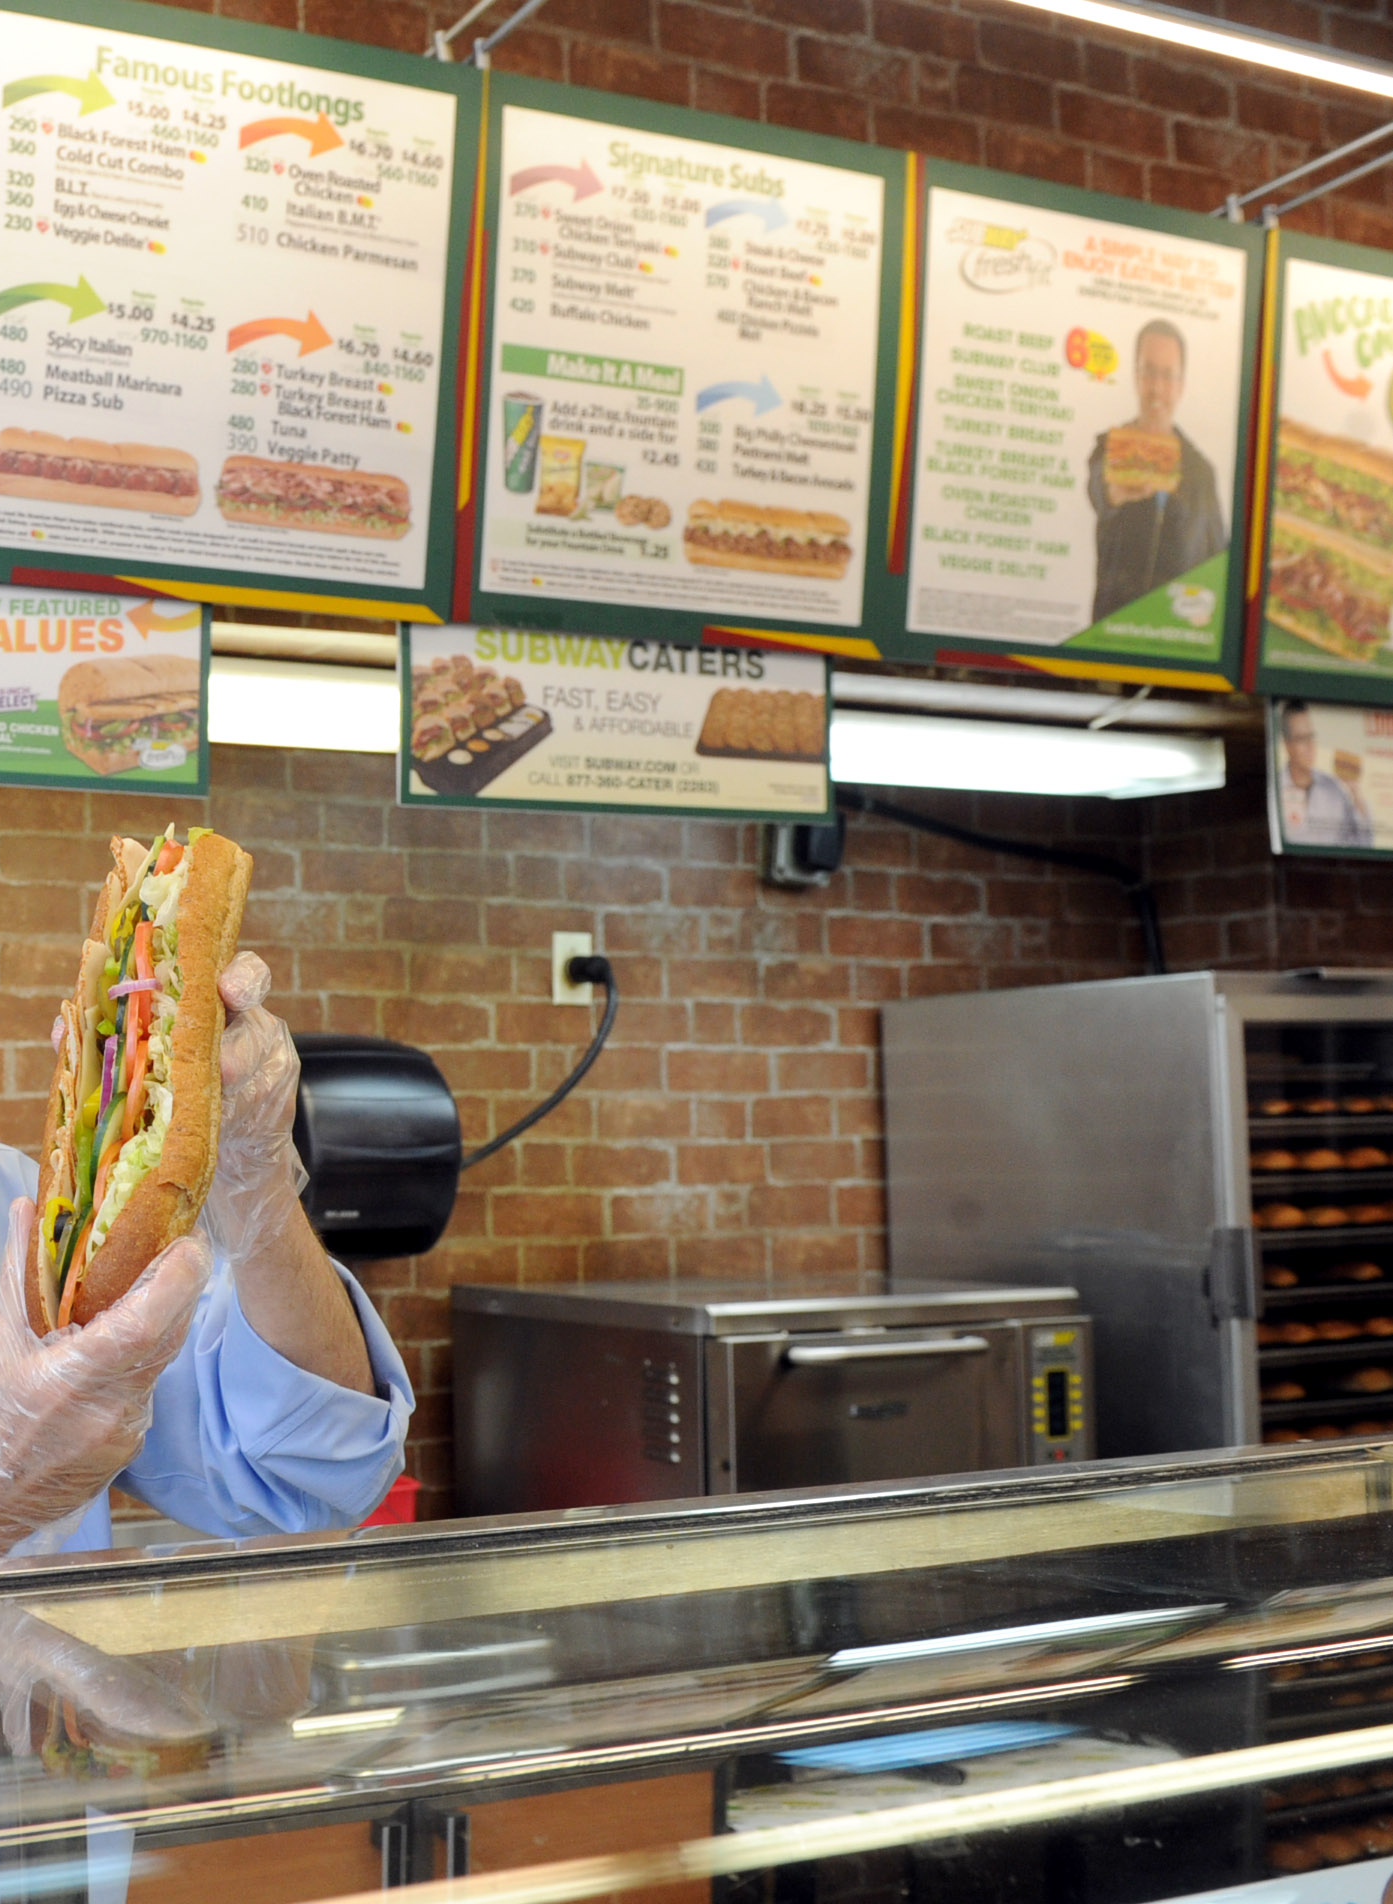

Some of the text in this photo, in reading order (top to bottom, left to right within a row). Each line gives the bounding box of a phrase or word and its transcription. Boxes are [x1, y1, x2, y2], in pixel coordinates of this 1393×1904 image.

[96, 45, 364, 126] Famous Footlongs
[56, 146, 92, 165] Cold
[97, 154, 124, 170] Cut
[128, 158, 184, 181] Combo
[609, 141, 785, 198] Signature Subs
[277, 231, 418, 271] Chicken Parmesan
[47, 331, 132, 356] Spicy Italian
[46, 365, 182, 396] Meatball Marinara
[277, 365, 325, 387] Turkey
[43, 386, 86, 405] Pizza
[91, 392, 124, 410] Sub
[276, 385, 323, 407] Turkey
[272, 421, 307, 438] Tuna
[268, 441, 318, 463] Veggie
[9, 598, 121, 616] FEATURED
[543, 686, 661, 712] FAST, EASY
[10, 723, 59, 736] CHICKEN
[589, 718, 694, 738] AFFORDABLE
[585, 758, 677, 773] SUBWAY.COM
